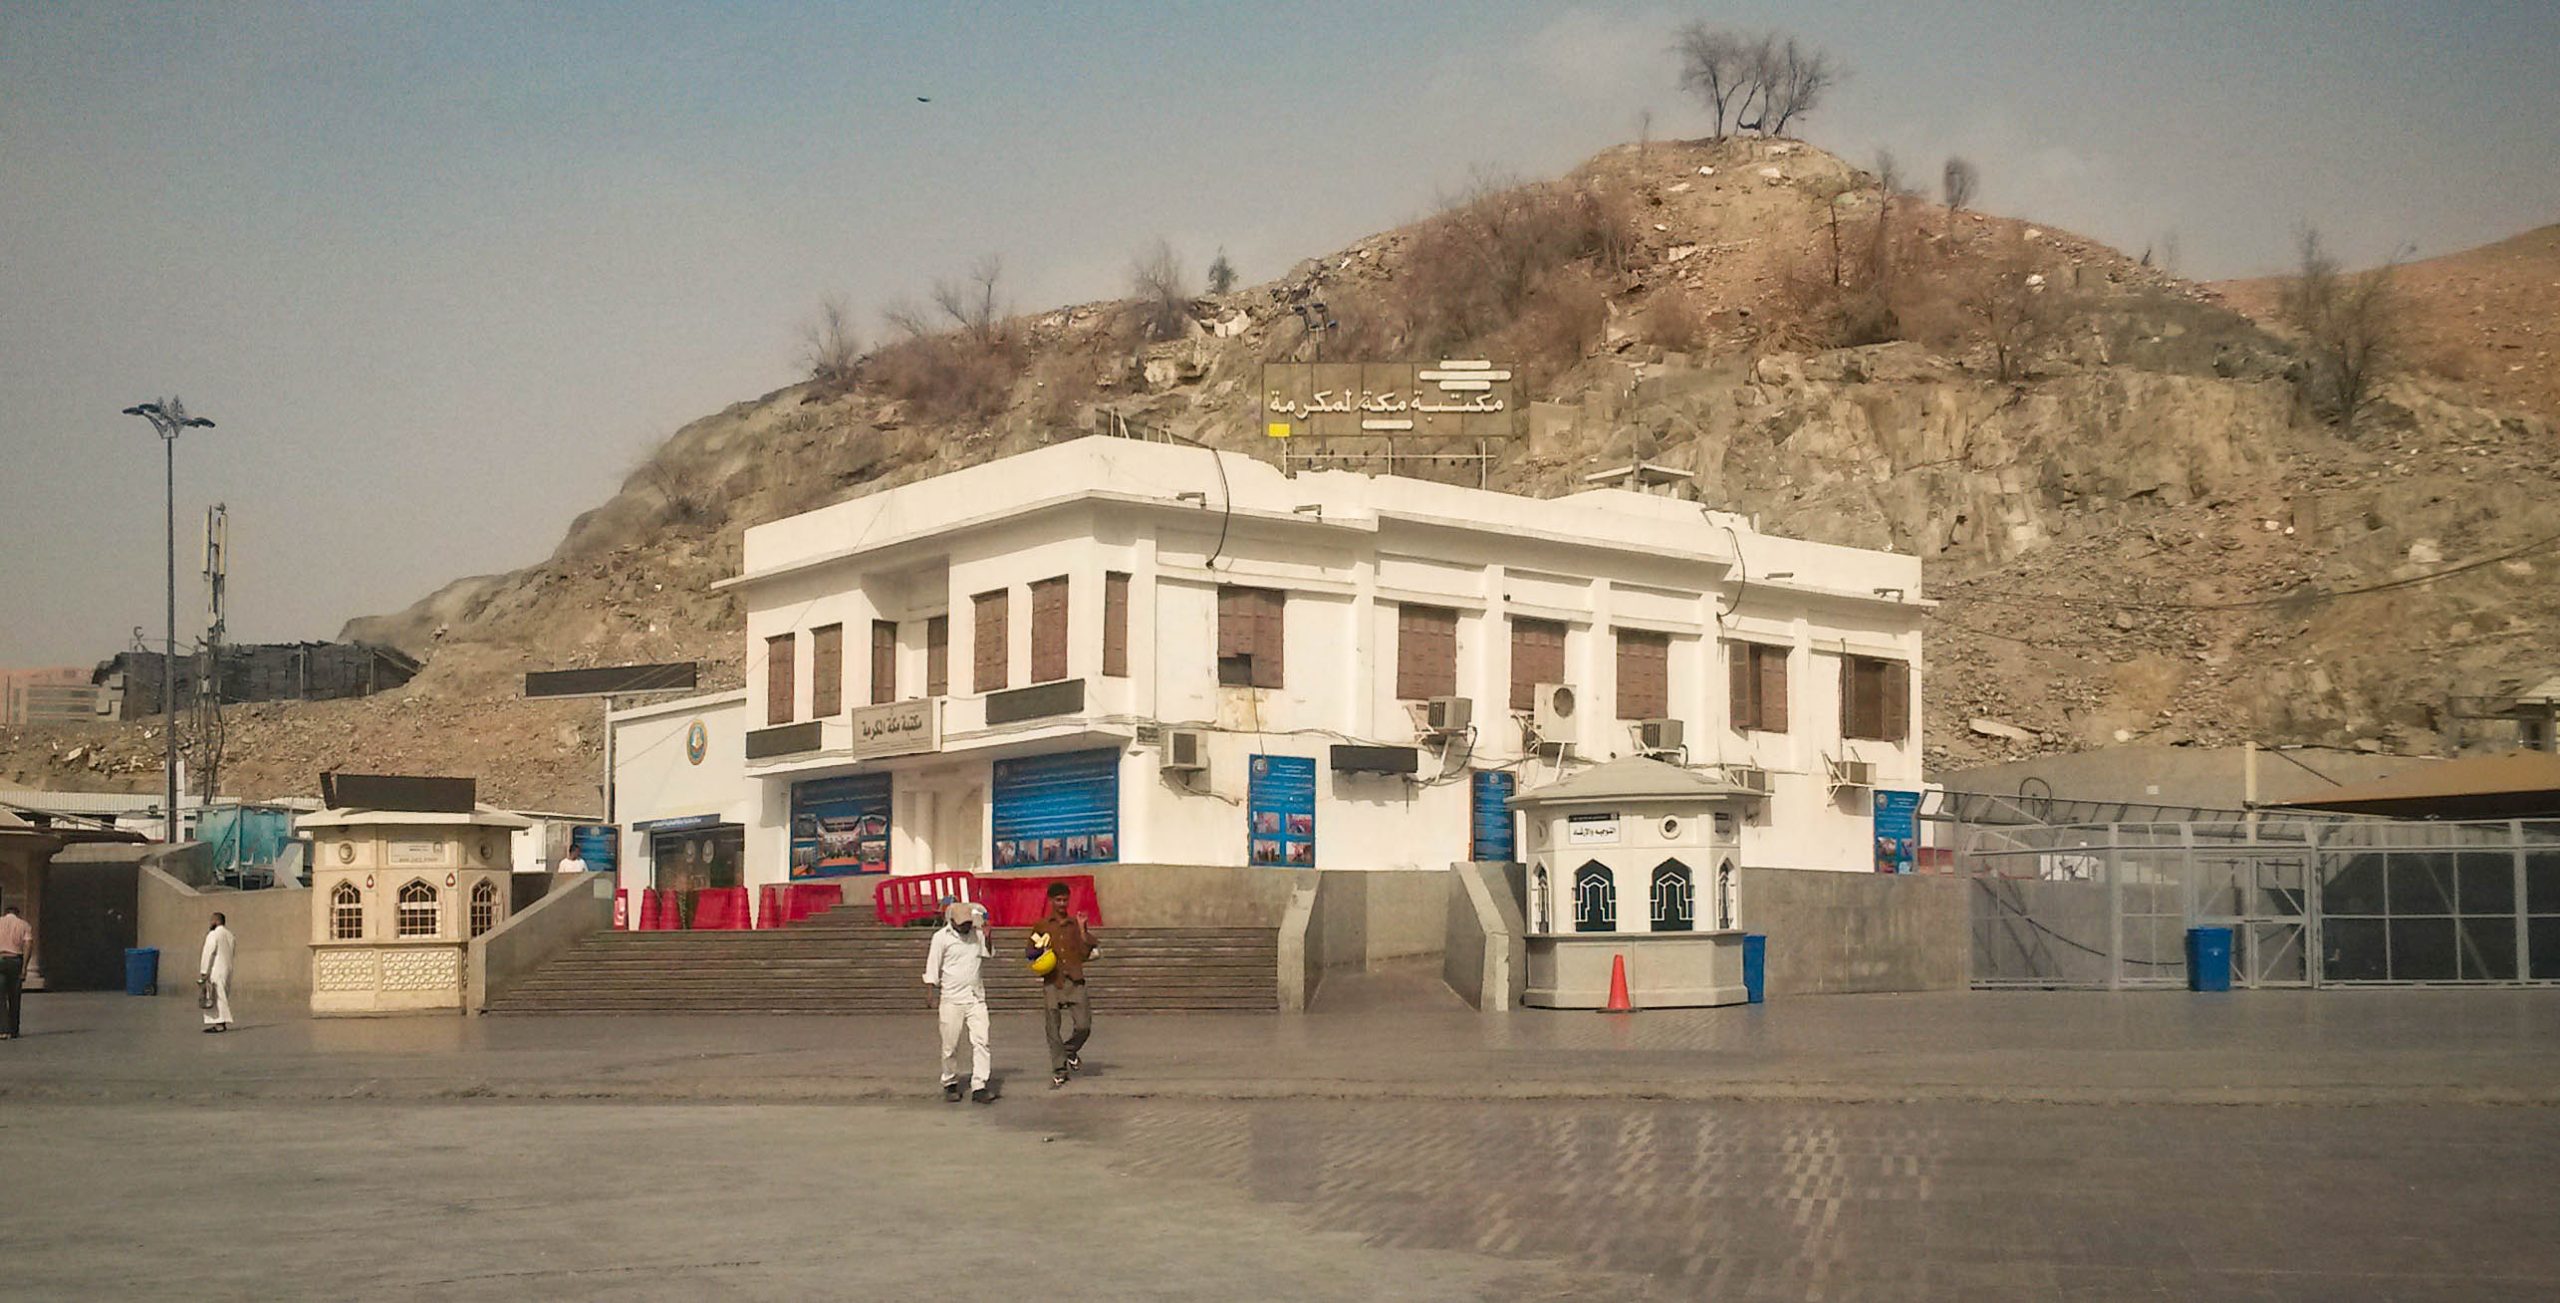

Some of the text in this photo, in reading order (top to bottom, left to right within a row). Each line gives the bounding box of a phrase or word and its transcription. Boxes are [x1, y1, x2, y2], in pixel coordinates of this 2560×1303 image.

[1360, 390, 1406, 412] مكة
[1411, 389, 1504, 422] مكتبة
[861, 714, 922, 740] مكتبة مكة المكرمة
